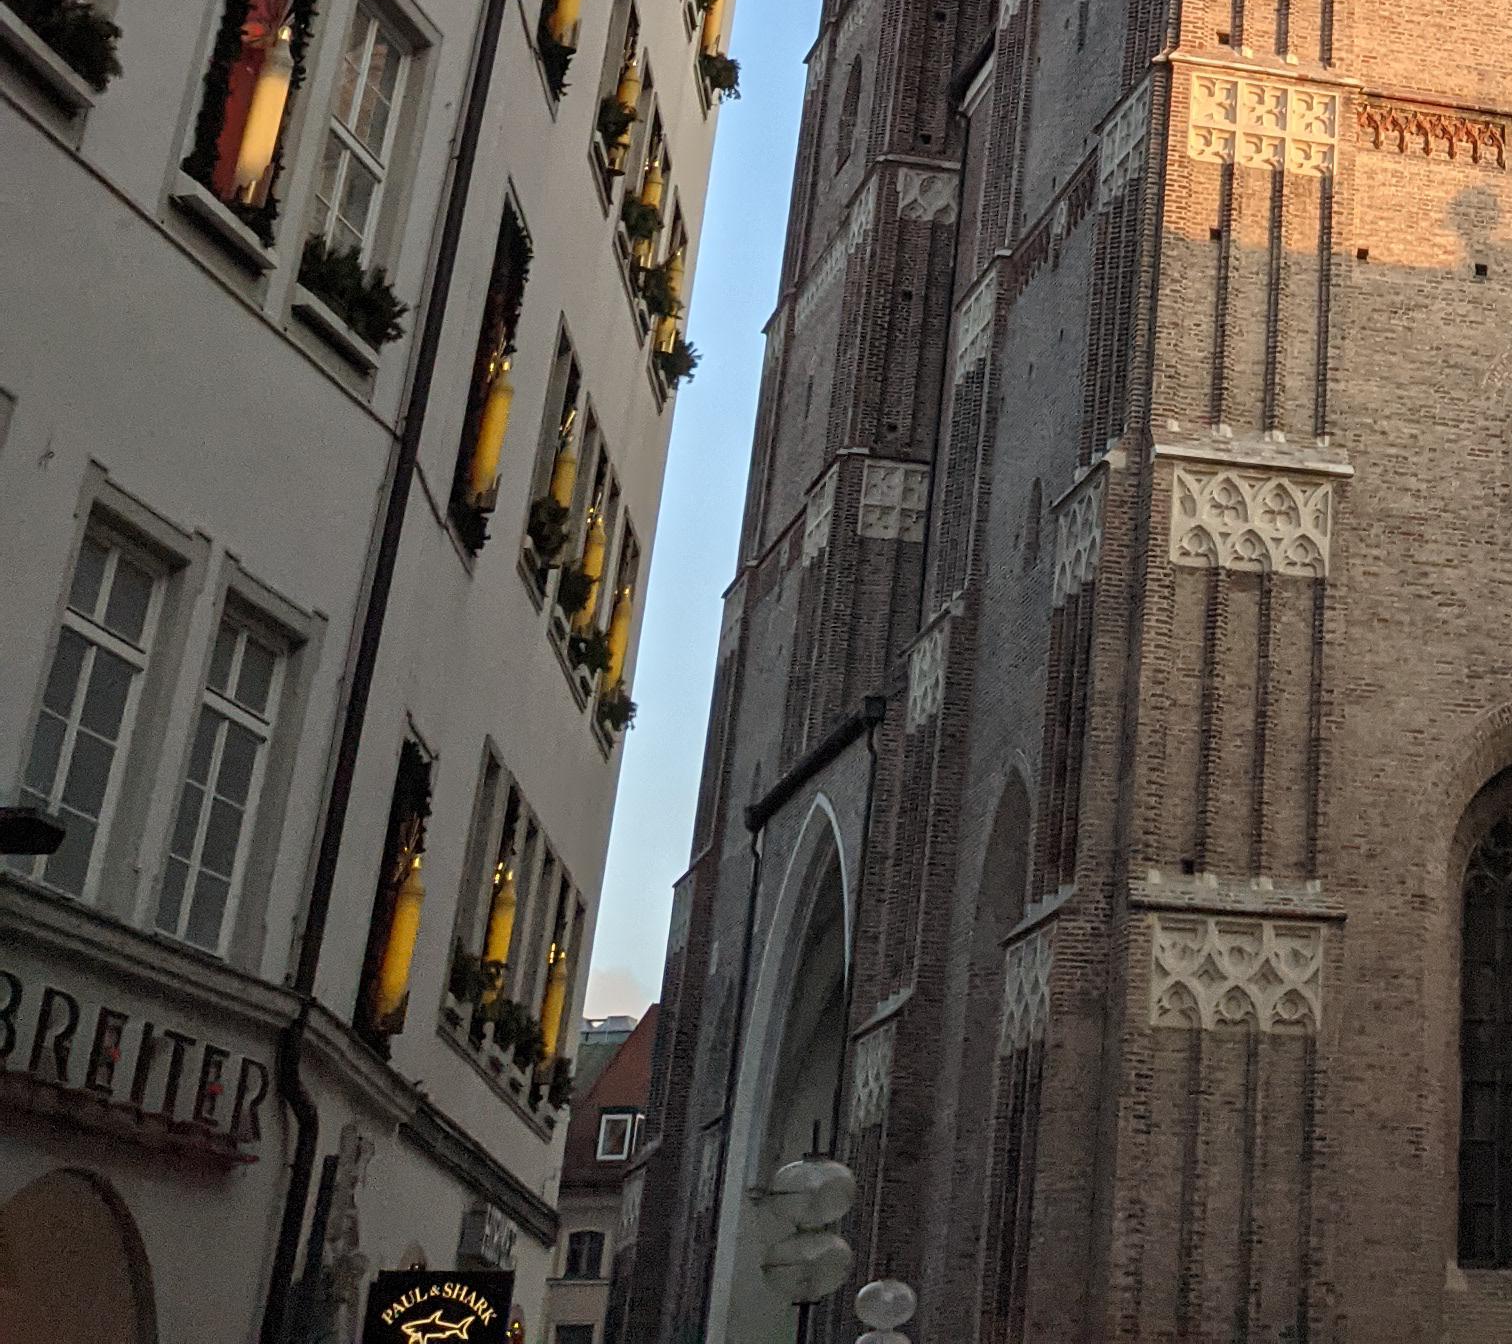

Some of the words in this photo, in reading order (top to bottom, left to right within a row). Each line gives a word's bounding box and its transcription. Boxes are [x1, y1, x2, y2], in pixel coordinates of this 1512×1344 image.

[381, 1286, 428, 1325] PAUL
[430, 1284, 441, 1296] &
[442, 1282, 498, 1326] SHARK
